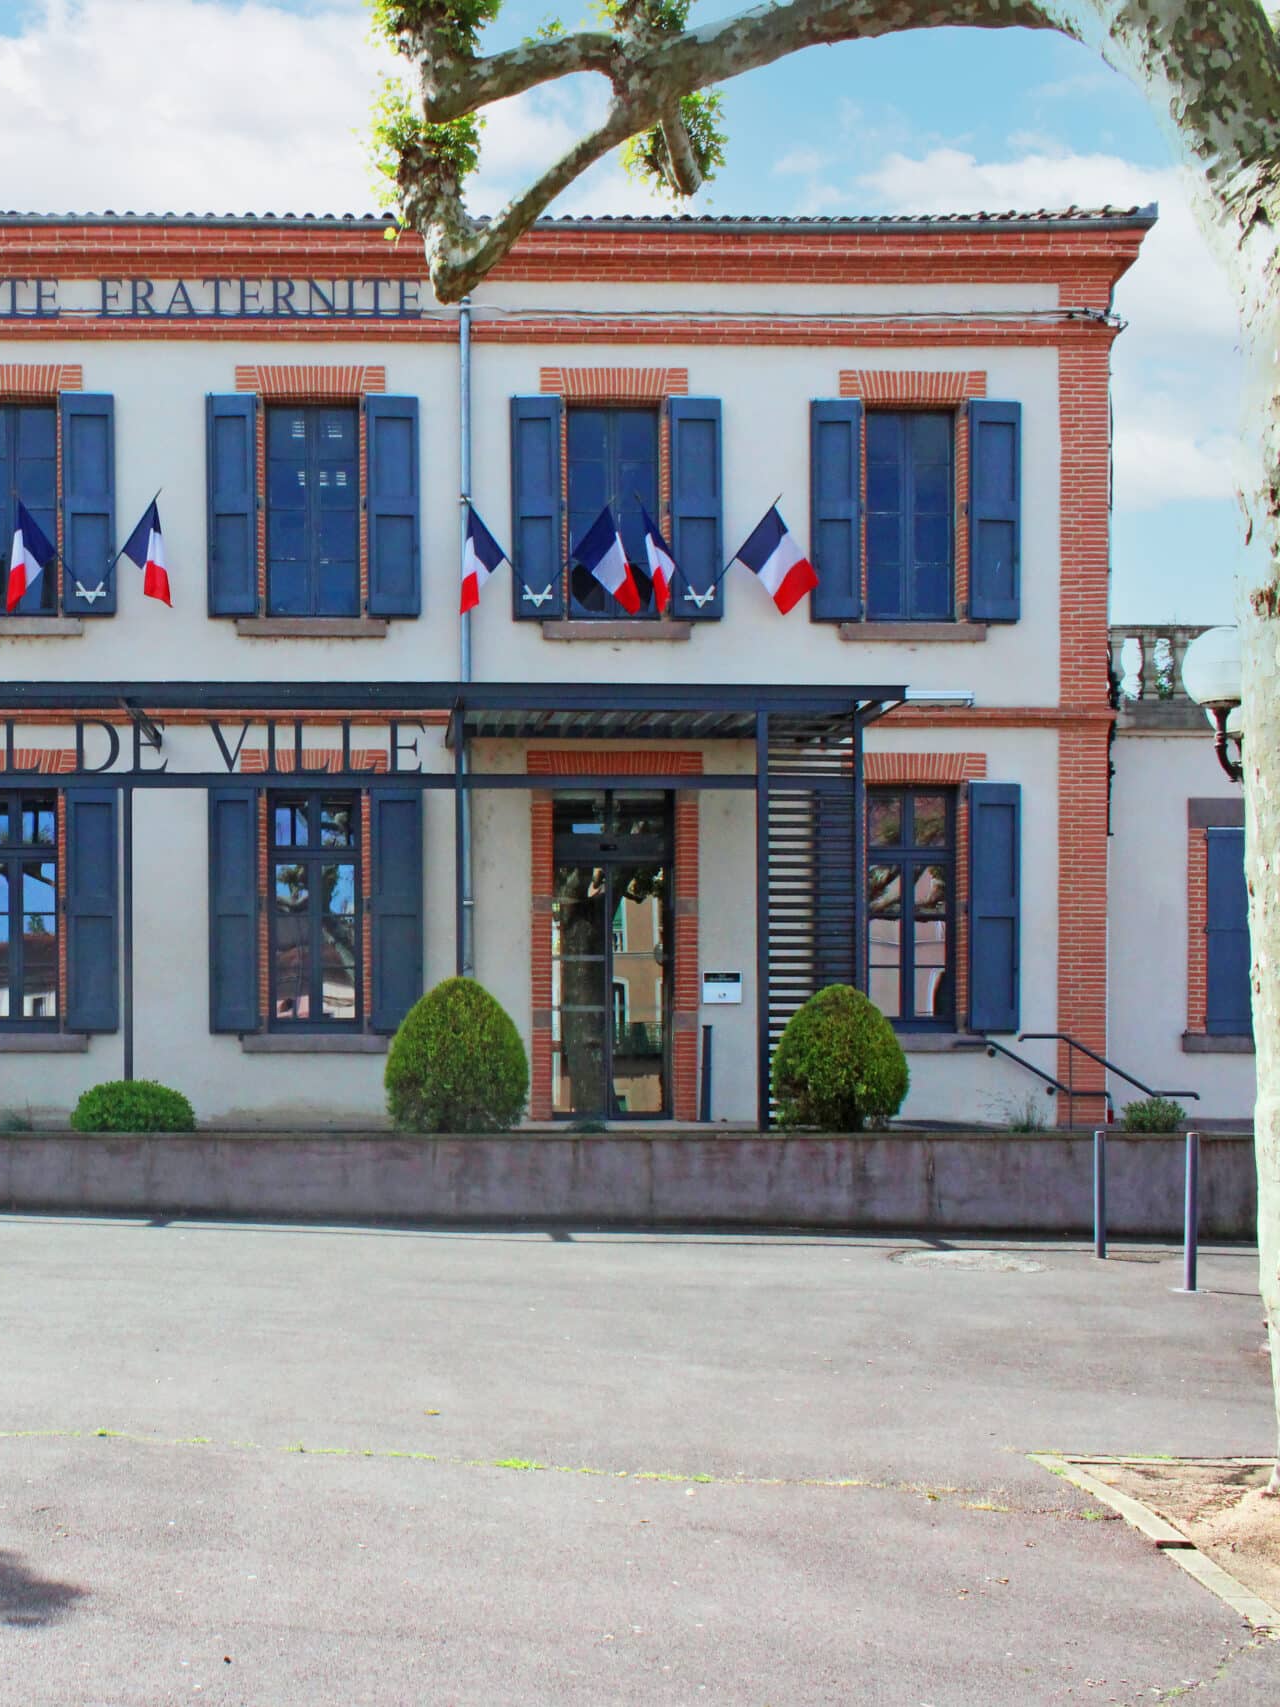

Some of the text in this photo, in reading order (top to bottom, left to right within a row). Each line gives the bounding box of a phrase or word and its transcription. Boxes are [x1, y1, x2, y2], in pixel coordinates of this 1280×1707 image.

[96, 276, 424, 320] FRATERNITE
[71, 718, 169, 774] DE
[206, 718, 426, 774] VILLE
